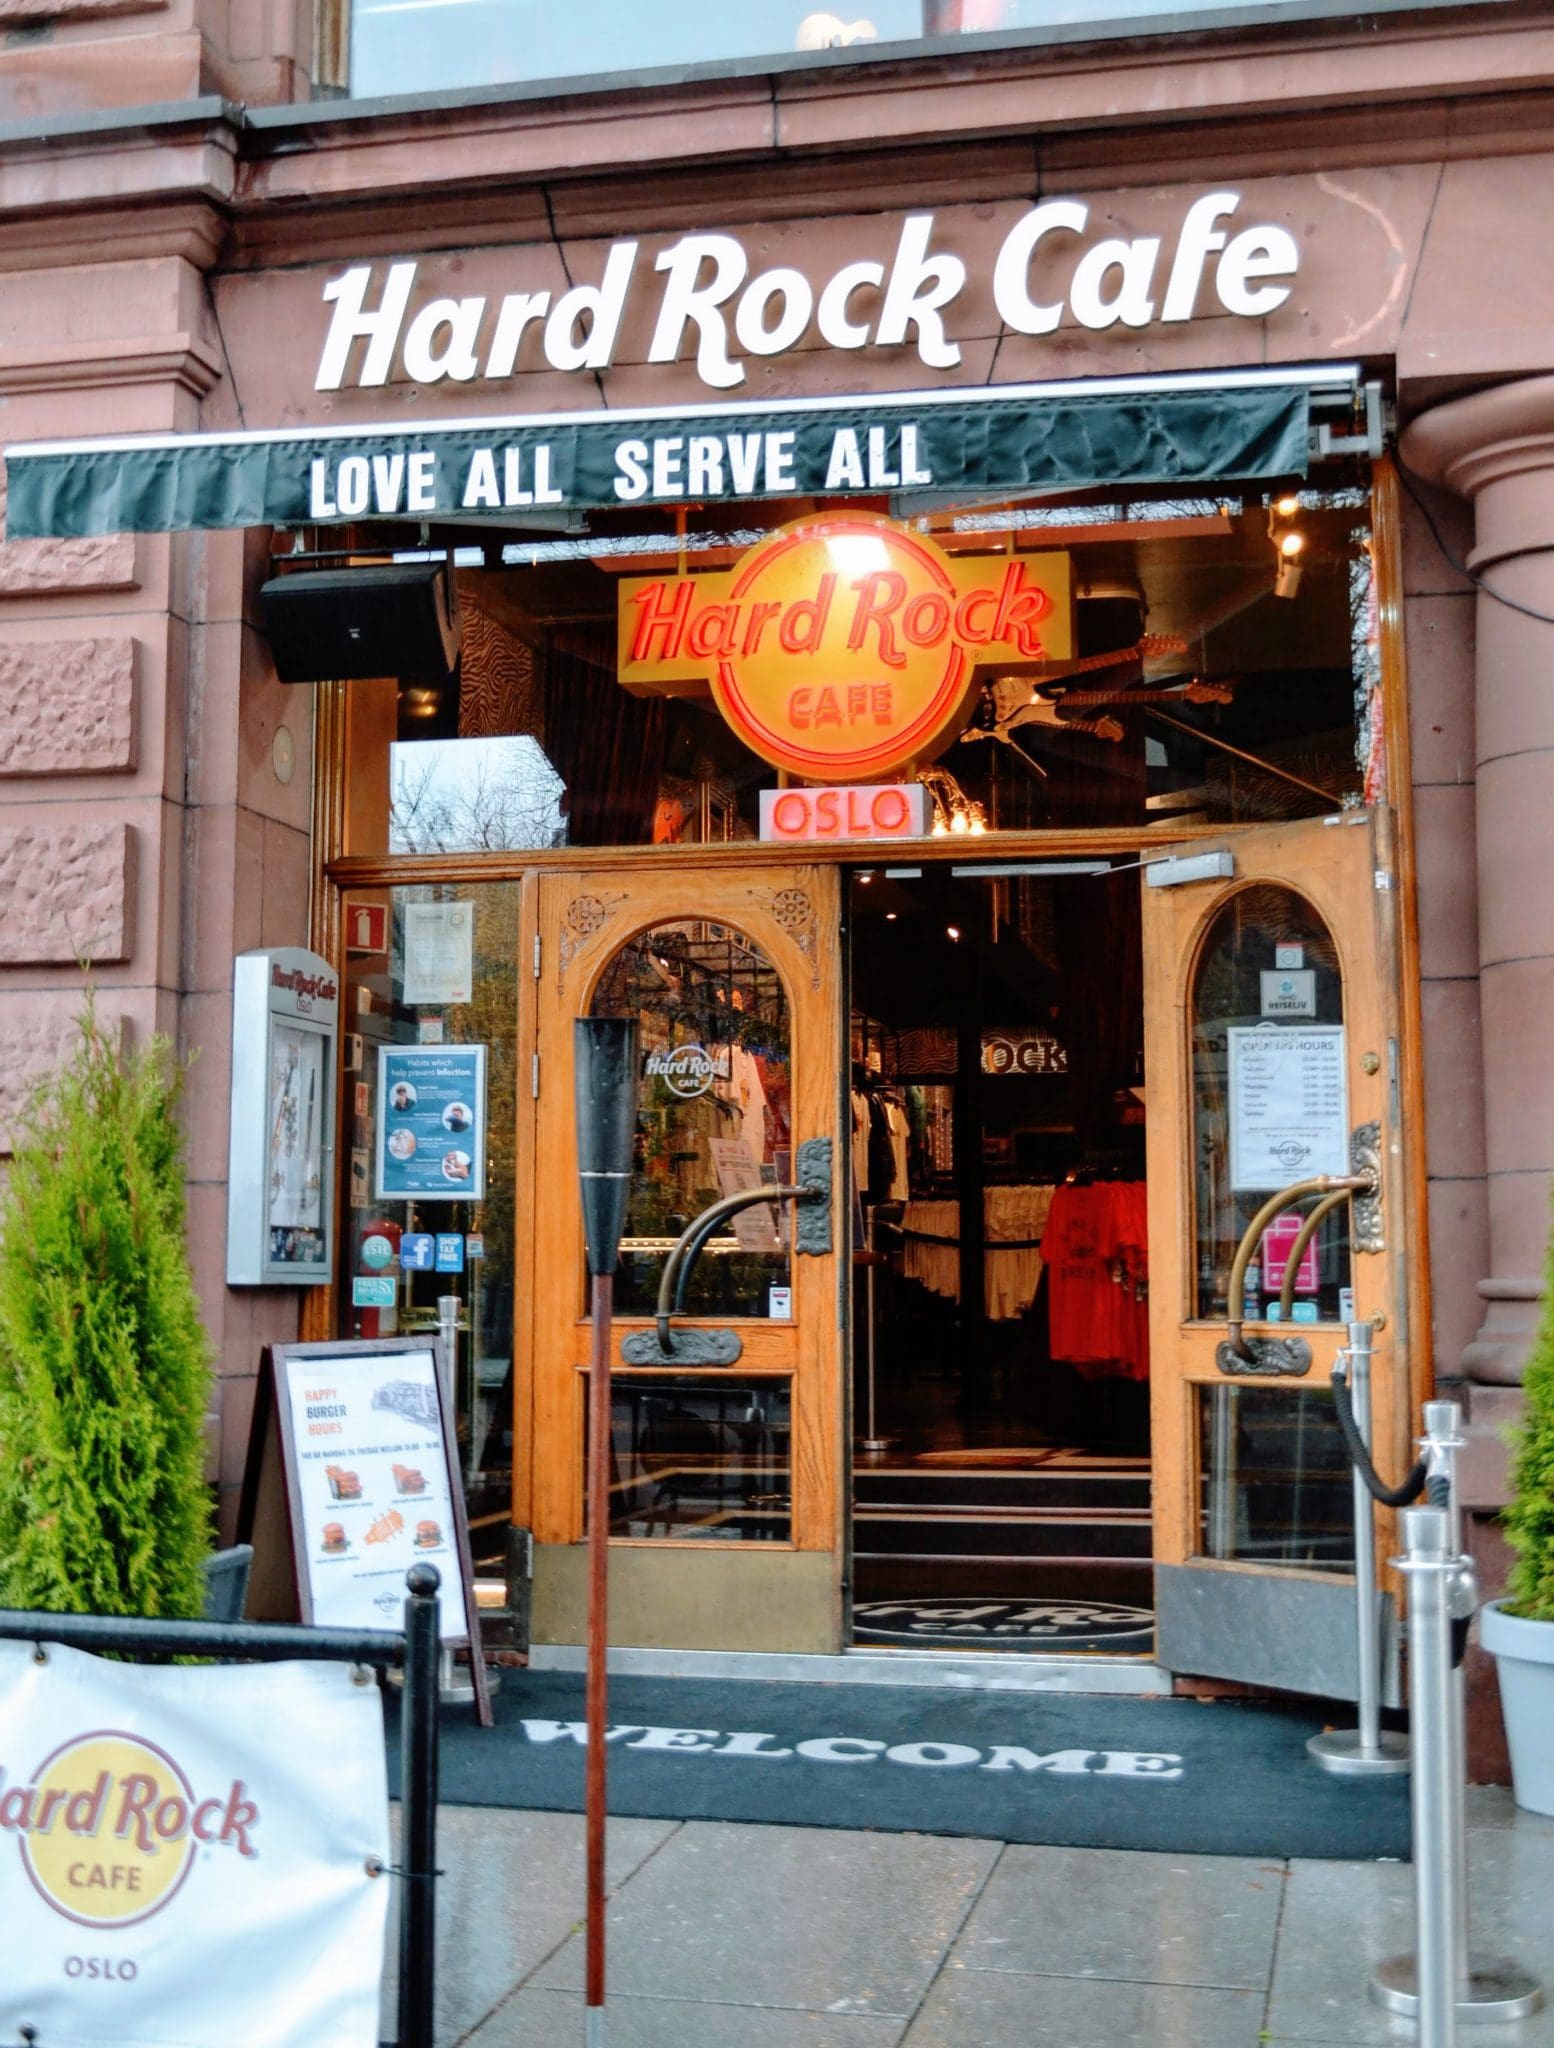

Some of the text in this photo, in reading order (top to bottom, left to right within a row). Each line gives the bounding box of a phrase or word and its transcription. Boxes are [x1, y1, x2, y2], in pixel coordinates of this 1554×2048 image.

[314, 192, 1300, 392] Hard Rock Cafe
[308, 424, 931, 520] LOVE ALL SERVE ALL
[628, 560, 1050, 669] Hard Rock
[788, 682, 894, 728] CAFE
[771, 789, 911, 836] OSLO
[1267, 1001, 1307, 1010] REISELIV
[1296, 1041, 1334, 1051] HOURS
[646, 1056, 688, 1074] Hard
[984, 1041, 1068, 1073] OCK
[436, 1068, 472, 1077] infection
[678, 1079, 700, 1088] CAFE
[440, 1245, 456, 1254] TAX
[304, 1387, 337, 1402] HAPPY
[306, 1403, 348, 1419] BURGER
[307, 1421, 344, 1437] HOURS
[1004, 1606, 1154, 1626] Ro
[909, 1622, 1060, 1633] CAFE
[518, 1718, 1185, 1779] WELCOME
[0, 1763, 260, 1860] ard Rock
[66, 1861, 143, 1892] CAFE
[63, 1955, 138, 1982] OSLO
